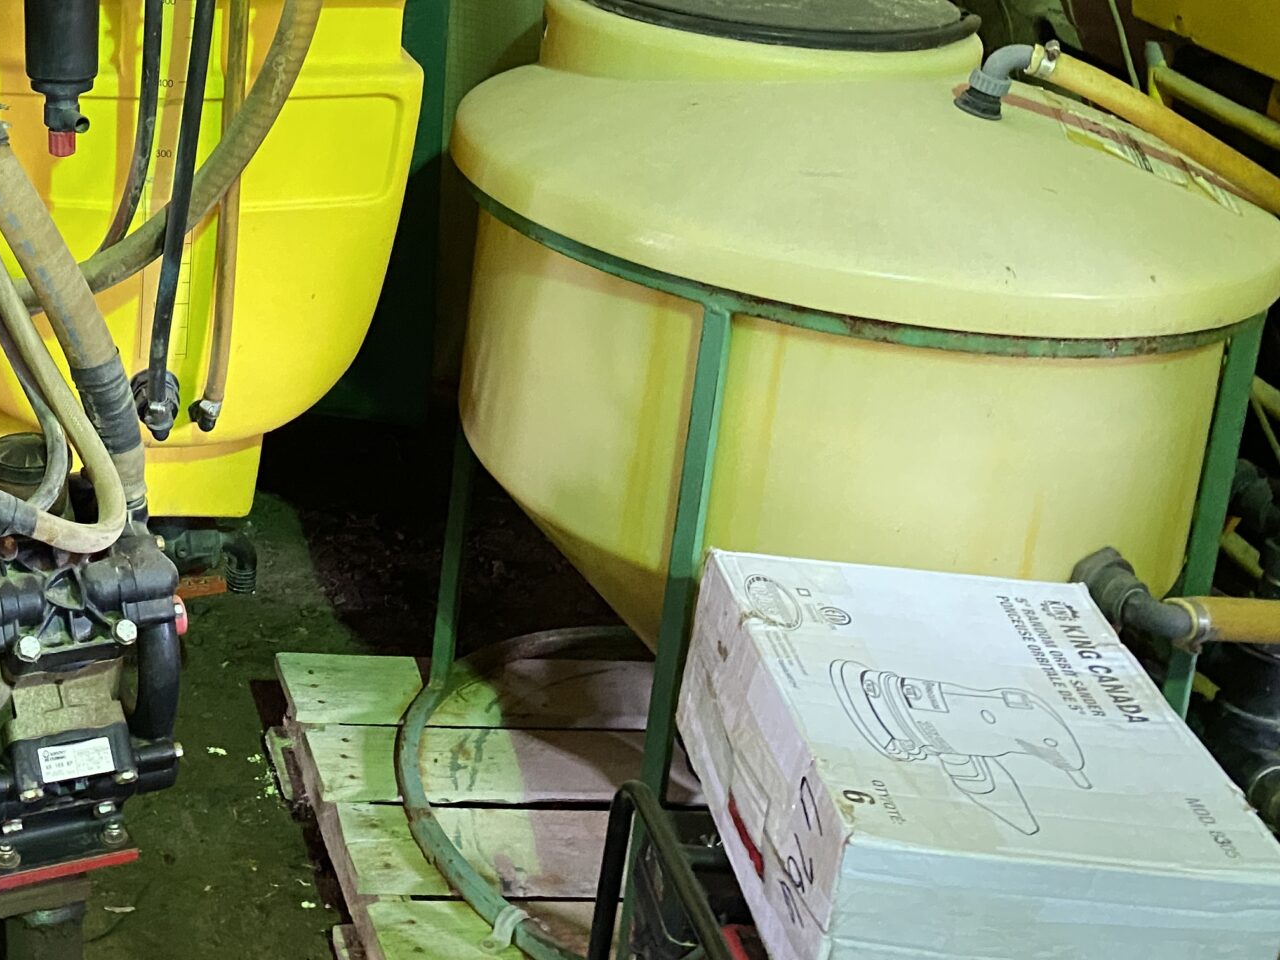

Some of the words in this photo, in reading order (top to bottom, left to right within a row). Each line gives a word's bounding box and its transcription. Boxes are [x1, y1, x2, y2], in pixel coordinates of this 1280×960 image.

[156, 149, 172, 158] 300
[995, 595, 1036, 642] PONCEUSE
[1027, 644, 1067, 689] ORBITALE
[1057, 689, 1075, 704] DE
[1022, 608, 1059, 648] RANDOM
[1049, 650, 1079, 678] ORBIT
[1070, 679, 1107, 717] SANDER
[1059, 624, 1103, 660] KING
[1088, 665, 1150, 723] CANADA
[842, 789, 876, 805] 6
[1184, 797, 1216, 827] MOD.
